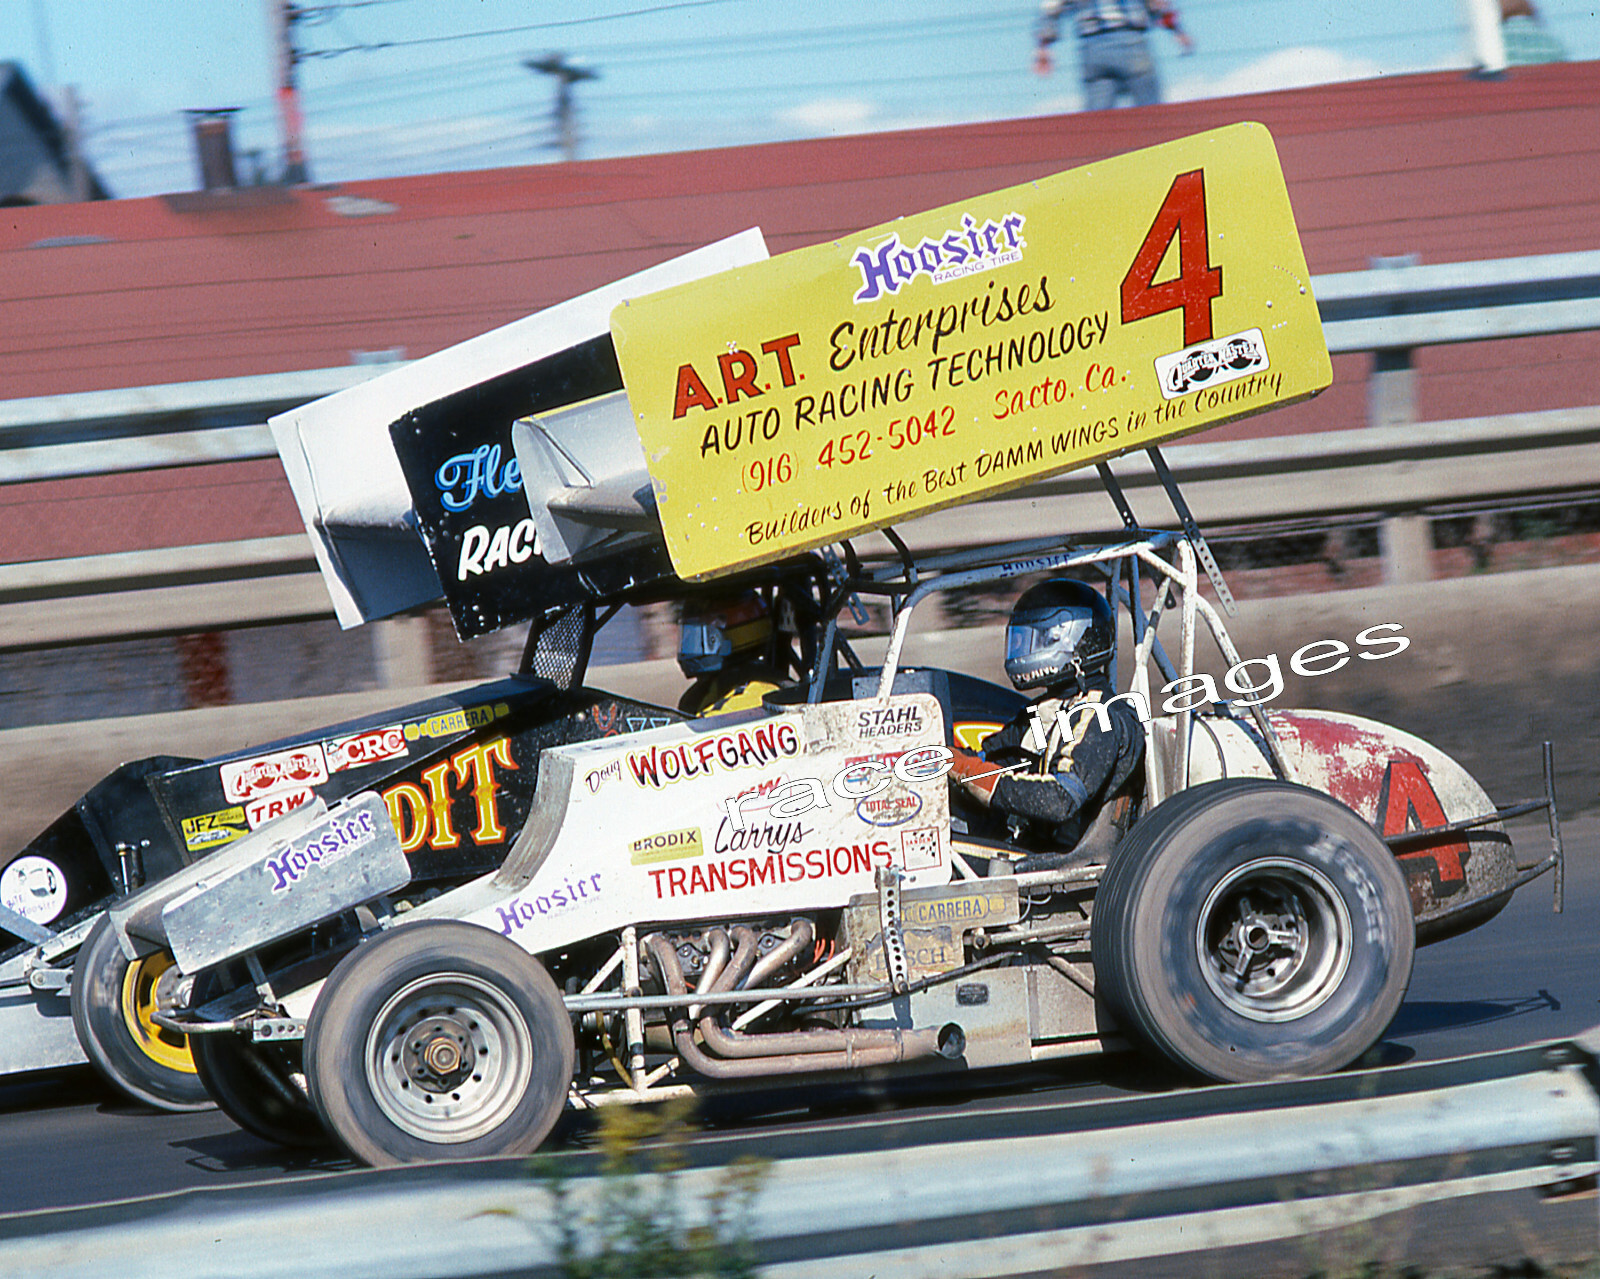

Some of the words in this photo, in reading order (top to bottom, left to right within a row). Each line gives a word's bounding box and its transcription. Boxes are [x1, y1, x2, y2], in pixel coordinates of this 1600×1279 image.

[855, 216, 1022, 300] Hoosier
[933, 261, 985, 283] RACING
[991, 251, 1021, 267] TIRE
[1119, 167, 1223, 348] 4
[672, 332, 807, 420] A.R.T.
[828, 275, 1056, 371] Enterprises
[700, 404, 781, 458] AUTO
[795, 369, 915, 431] RACING
[927, 311, 1110, 391] TECHNOLOGY
[740, 452, 800, 493] (916)
[817, 405, 957, 469] 452-5042
[991, 377, 1074, 420] Sacto.
[1084, 362, 1128, 393] Ca.
[435, 443, 524, 513] Fle
[745, 500, 842, 546] Builders
[850, 489, 872, 519] of
[882, 474, 918, 505] the
[922, 462, 968, 495] Best
[975, 439, 1044, 478] DAMM
[1051, 416, 1119, 456] WINGS
[1127, 410, 1148, 433] in
[1153, 399, 1187, 425] the
[1194, 371, 1284, 414] Country
[431, 708, 489, 735] CARRERA
[857, 706, 921, 728] STAHL
[859, 721, 922, 738] HEADERS
[342, 731, 404, 763] CRC
[585, 760, 622, 793] Doug
[628, 723, 798, 788] WOLFGANG
[187, 814, 218, 834] JFZ
[251, 792, 306, 823] TRW
[381, 738, 519, 853] DIT
[865, 799, 892, 812] TOTAL
[895, 796, 917, 808] SEAL
[267, 812, 370, 891] Hoosier
[633, 830, 698, 851] BRODIX
[714, 816, 815, 854] Larrys
[1375, 760, 1472, 898] 4
[648, 841, 892, 899] TRANSMISSIONS
[495, 873, 601, 936] Hoosier
[918, 897, 983, 920] CARRERA
[875, 946, 945, 970] SCH
